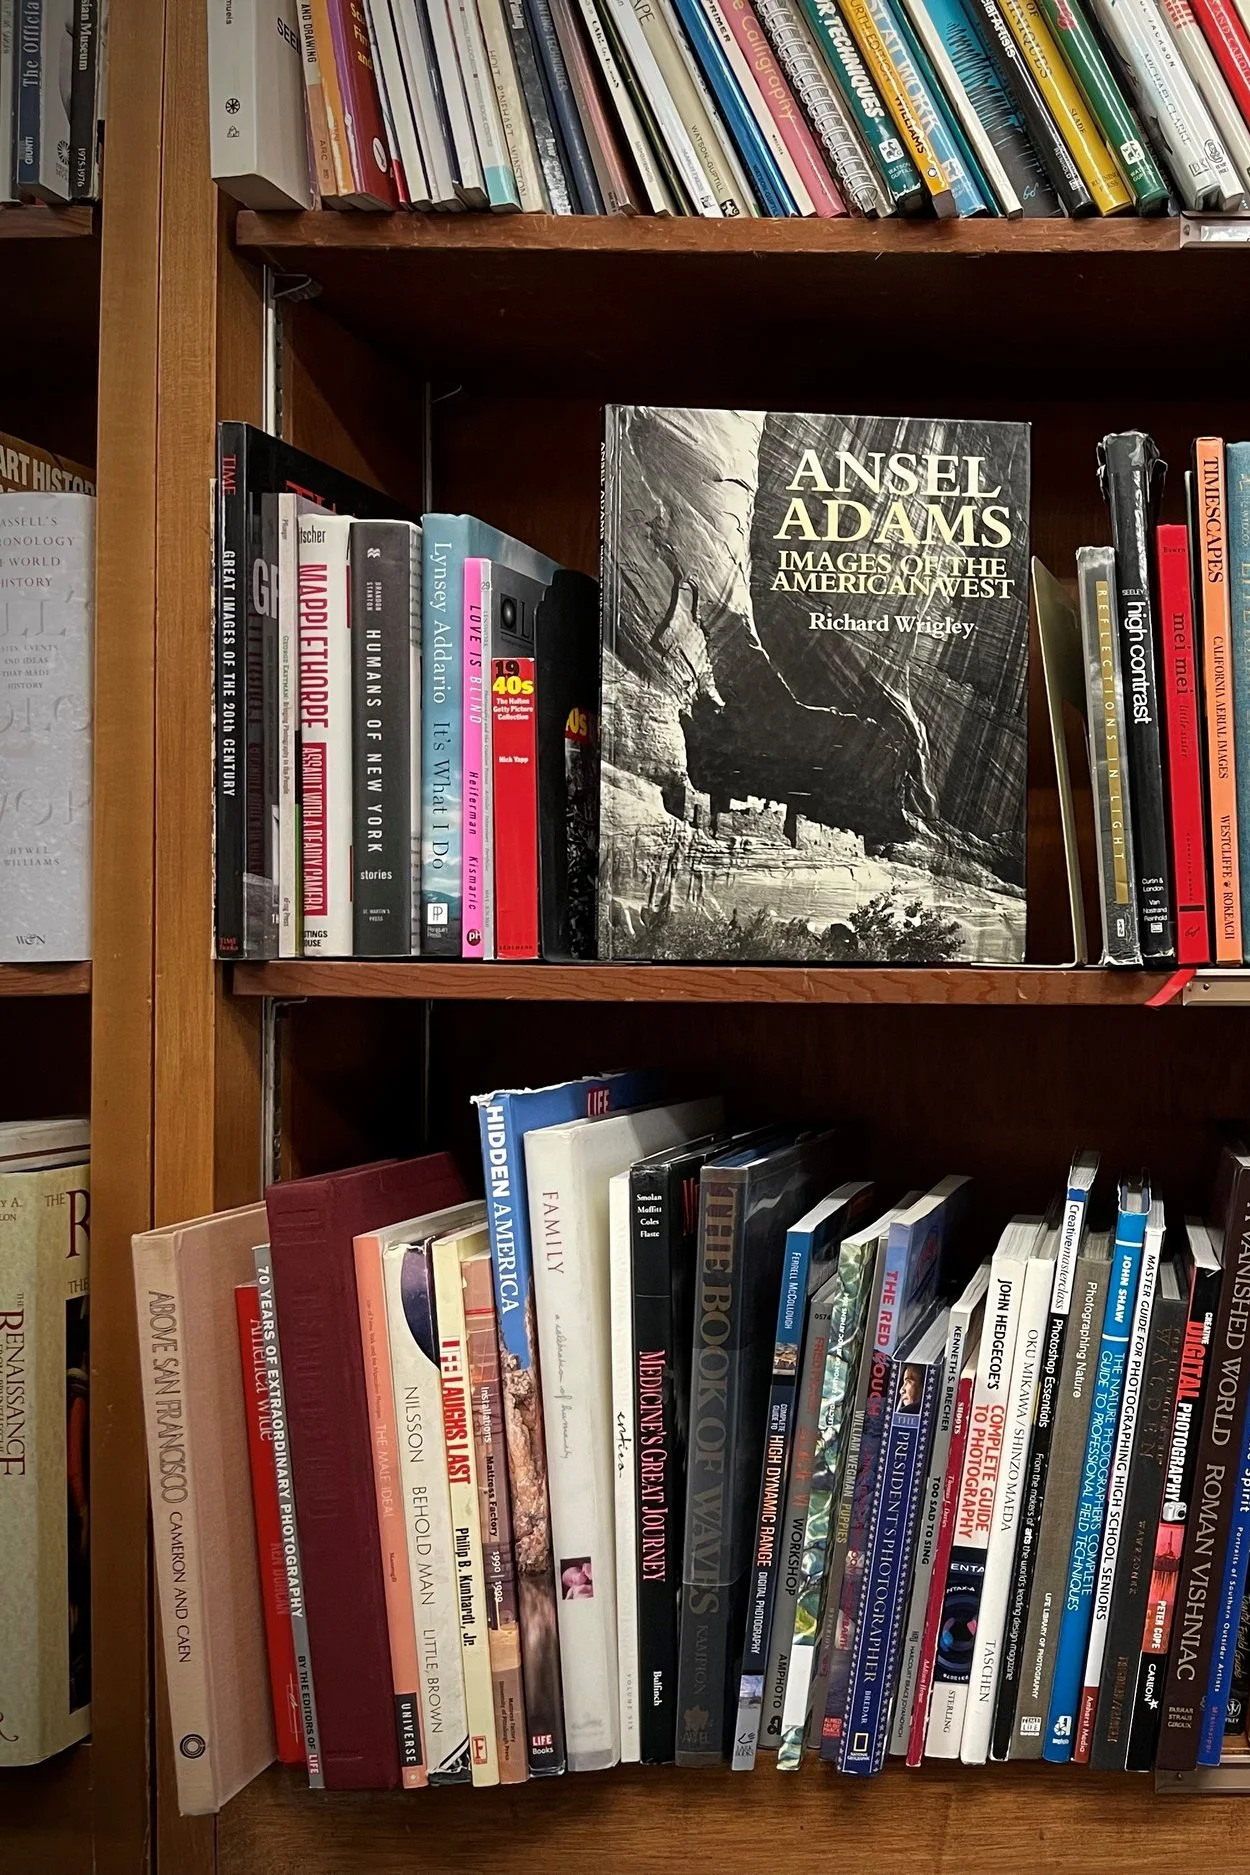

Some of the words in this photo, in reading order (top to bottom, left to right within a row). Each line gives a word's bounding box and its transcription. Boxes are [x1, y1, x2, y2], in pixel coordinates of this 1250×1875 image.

[301, 4, 312, 21] AND
[78, 23, 91, 71] Museum
[303, 24, 317, 63] DRAWING
[742, 16, 797, 122] Calligraphy
[823, 20, 885, 118] TECHNIQUES
[77, 148, 87, 187] 1975-1976
[690, 125, 724, 193] WATSON-GUPTILL
[785, 449, 1002, 498] ANSEL
[773, 497, 1012, 548] ADAMS
[1203, 456, 1223, 583] TIMESCAPES
[221, 550, 235, 591] GREAT
[432, 542, 452, 613] Lynsey
[770, 571, 932, 596] AMERICAN
[938, 577, 1015, 599] WEST
[778, 550, 892, 574] IMAGES
[900, 554, 938, 576] OF
[947, 556, 1007, 578] THE
[221, 597, 235, 646] IMAGES
[468, 605, 482, 643] LOVE
[808, 612, 890, 632] Richard
[895, 615, 975, 639] Wrigley
[1126, 600, 1147, 643] high
[222, 651, 235, 667] OF
[365, 630, 383, 707] HUMANS
[432, 620, 451, 704] Addario
[469, 651, 482, 668] IS
[1213, 636, 1225, 697] CALIFORNIA
[222, 673, 235, 698] THE
[469, 675, 483, 725] BLIND
[1129, 644, 1151, 724] contrast
[222, 703, 236, 733] 20th
[366, 720, 382, 741] OF
[432, 722, 450, 752] It's
[1216, 701, 1227, 737] AERIAL
[223, 738, 237, 796] CENTURY
[367, 754, 382, 791] NEW
[1218, 740, 1228, 779] IMAGES
[431, 759, 450, 812] What
[468, 771, 479, 835] Heiferman
[367, 804, 383, 853] YORK
[361, 870, 393, 881] stories
[431, 838, 448, 869] Do
[468, 856, 479, 910] Kismaric
[486, 1106, 510, 1198] HIDDEN
[542, 1192, 564, 1274] FAMILY
[258, 1265, 270, 1286] 70
[493, 1202, 519, 1314] AMERICA
[259, 1289, 275, 1340] YEARS
[1076, 1282, 1097, 1359] Photographing
[265, 1345, 278, 1365] OF
[1072, 1361, 1088, 1398] Nature
[638, 1350, 667, 1445] MEDICINE'S
[1211, 1357, 1241, 1446] WORLD
[266, 1369, 291, 1498] EXTRAORDINARY
[767, 1435, 785, 1463] HIGH
[640, 1449, 667, 1501] GREAT
[761, 1467, 780, 1523] DYNAMIC
[930, 1477, 941, 1497] TOO
[412, 1486, 430, 1555] BEHOLD
[926, 1523, 935, 1537] TO
[928, 1501, 938, 1521] SAD
[1195, 1464, 1225, 1556] ROMAN
[169, 1511, 185, 1583] CAMERON
[279, 1504, 303, 1618] PHOTOGRAPHY
[640, 1506, 668, 1583] JOURNEY
[756, 1526, 773, 1567] RANGE
[921, 1540, 932, 1565] SING
[175, 1588, 188, 1619] AND
[418, 1563, 435, 1605] MAN
[863, 1539, 895, 1683] PHOTOGRAPHER
[1176, 1563, 1211, 1681] VISHNIAC
[177, 1625, 191, 1663] CAEN
[653, 1671, 662, 1706] Bulfinch
[773, 1654, 787, 1708] AMPHOTO
[979, 1640, 996, 1703] TASCHEN
[401, 1703, 417, 1763] UNIVERSE
